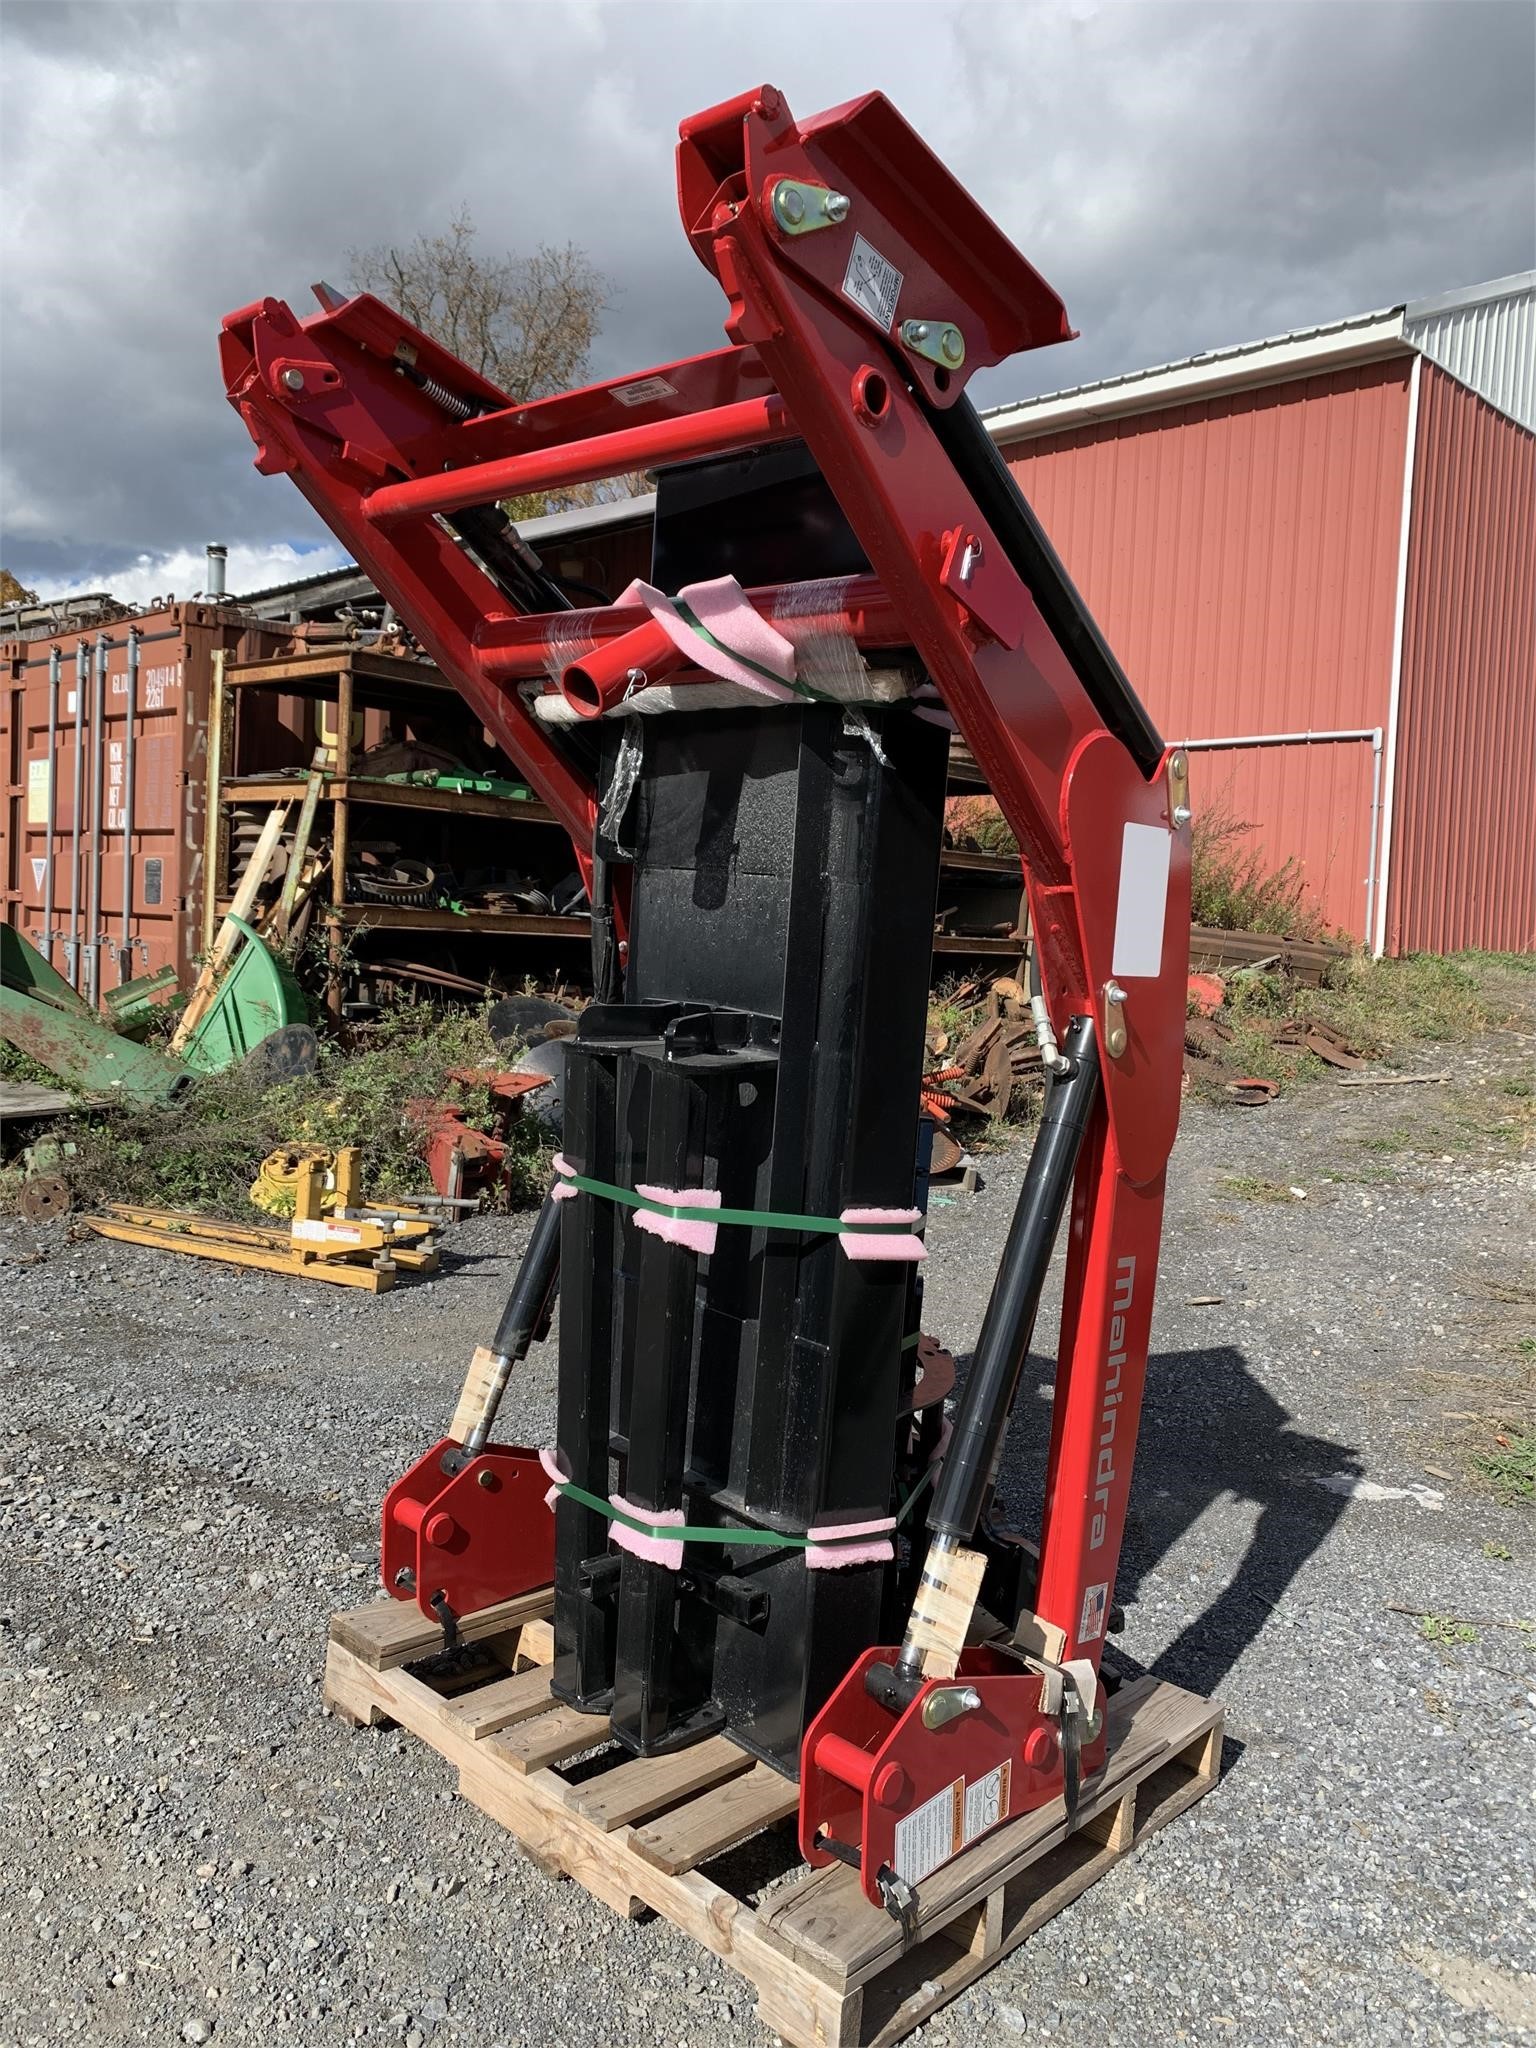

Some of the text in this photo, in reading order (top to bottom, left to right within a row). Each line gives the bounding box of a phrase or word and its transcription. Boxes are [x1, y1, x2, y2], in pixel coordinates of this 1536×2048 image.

[883, 273, 900, 327] IMPORTANT
[108, 786, 120, 807] NET
[1090, 1256, 1136, 1550] mahindra
